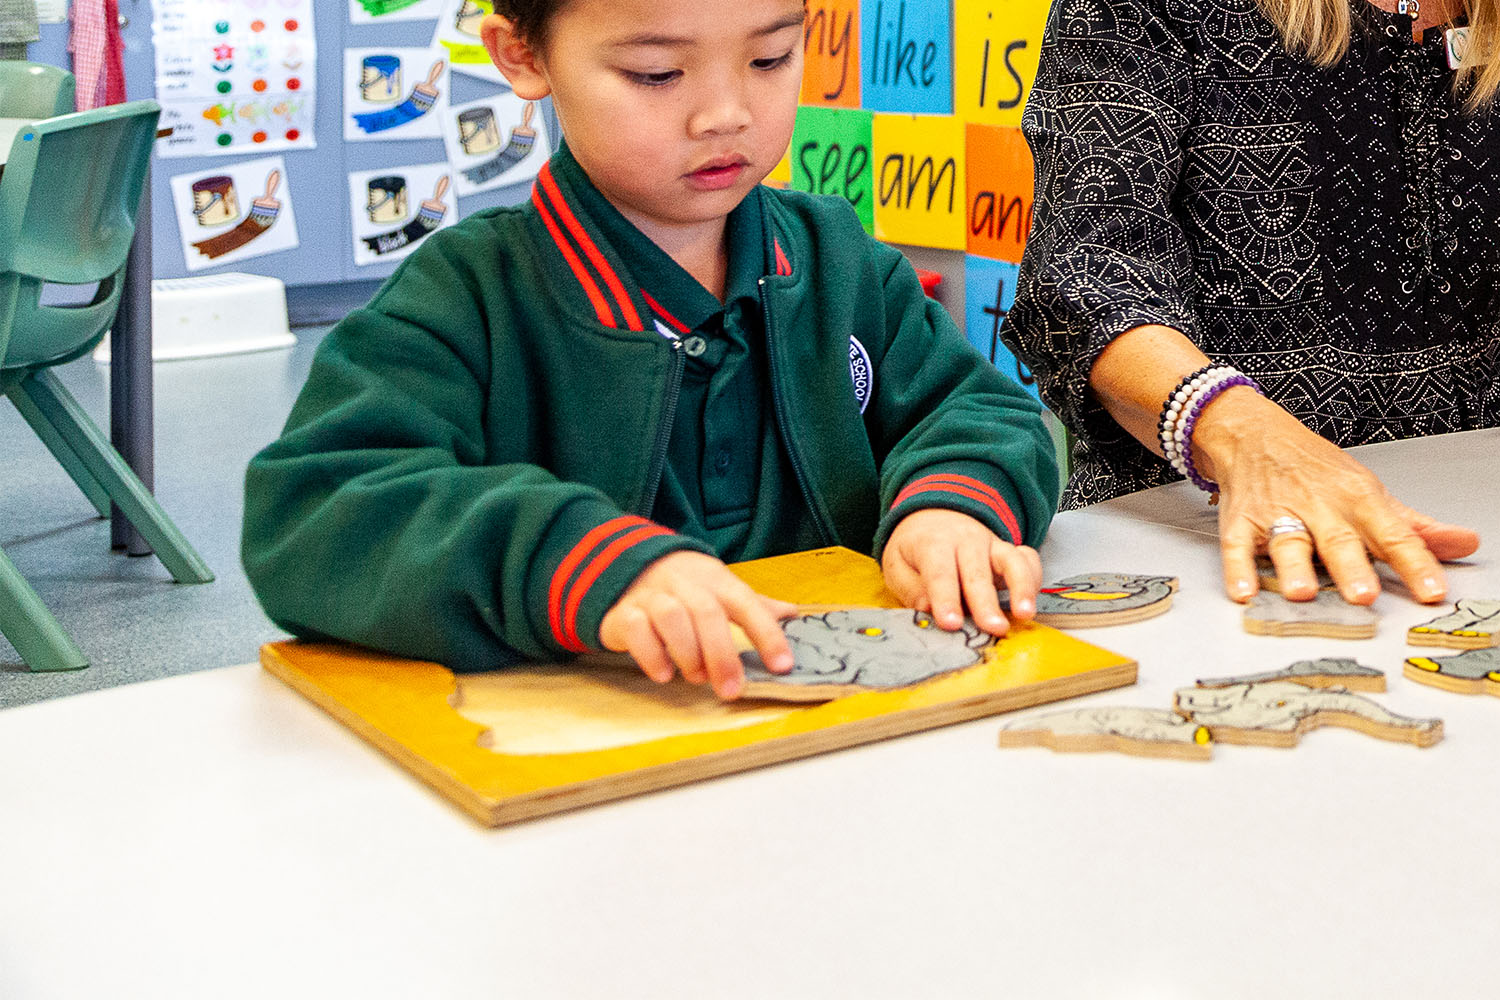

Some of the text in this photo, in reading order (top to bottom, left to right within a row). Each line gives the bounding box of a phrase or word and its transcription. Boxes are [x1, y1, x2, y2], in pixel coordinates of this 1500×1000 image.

[870, 0, 937, 88] like
[978, 11, 1028, 110] is
[799, 141, 1034, 244] see am an
